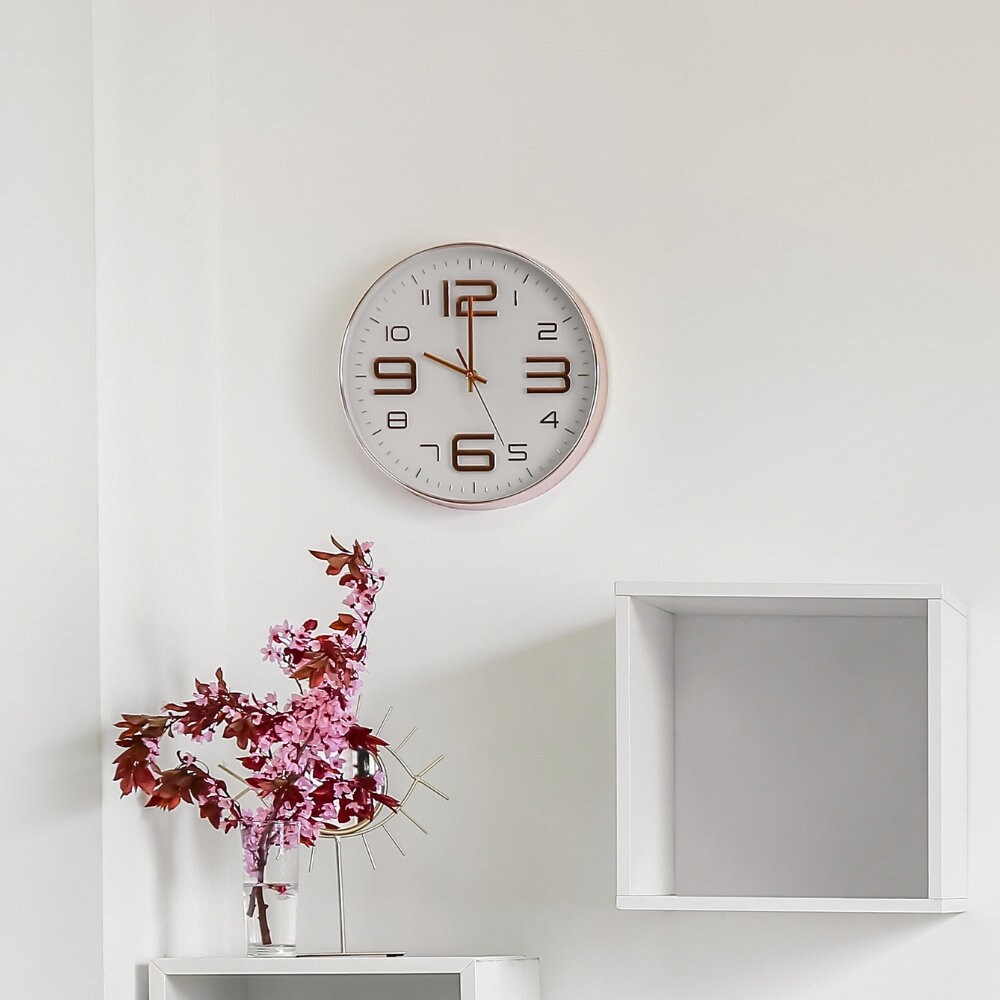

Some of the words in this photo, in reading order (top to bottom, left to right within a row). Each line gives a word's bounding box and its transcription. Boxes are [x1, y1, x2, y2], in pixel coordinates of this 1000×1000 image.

[442, 279, 498, 318] 12
[385, 325, 411, 342] 10
[537, 322, 558, 340] 2
[373, 356, 417, 396] 9
[525, 356, 571, 394] 3
[387, 411, 408, 429] 8
[539, 410, 559, 429] 4
[419, 443, 440, 462] 7
[451, 433, 496, 472] 6
[507, 443, 528, 462] 5
